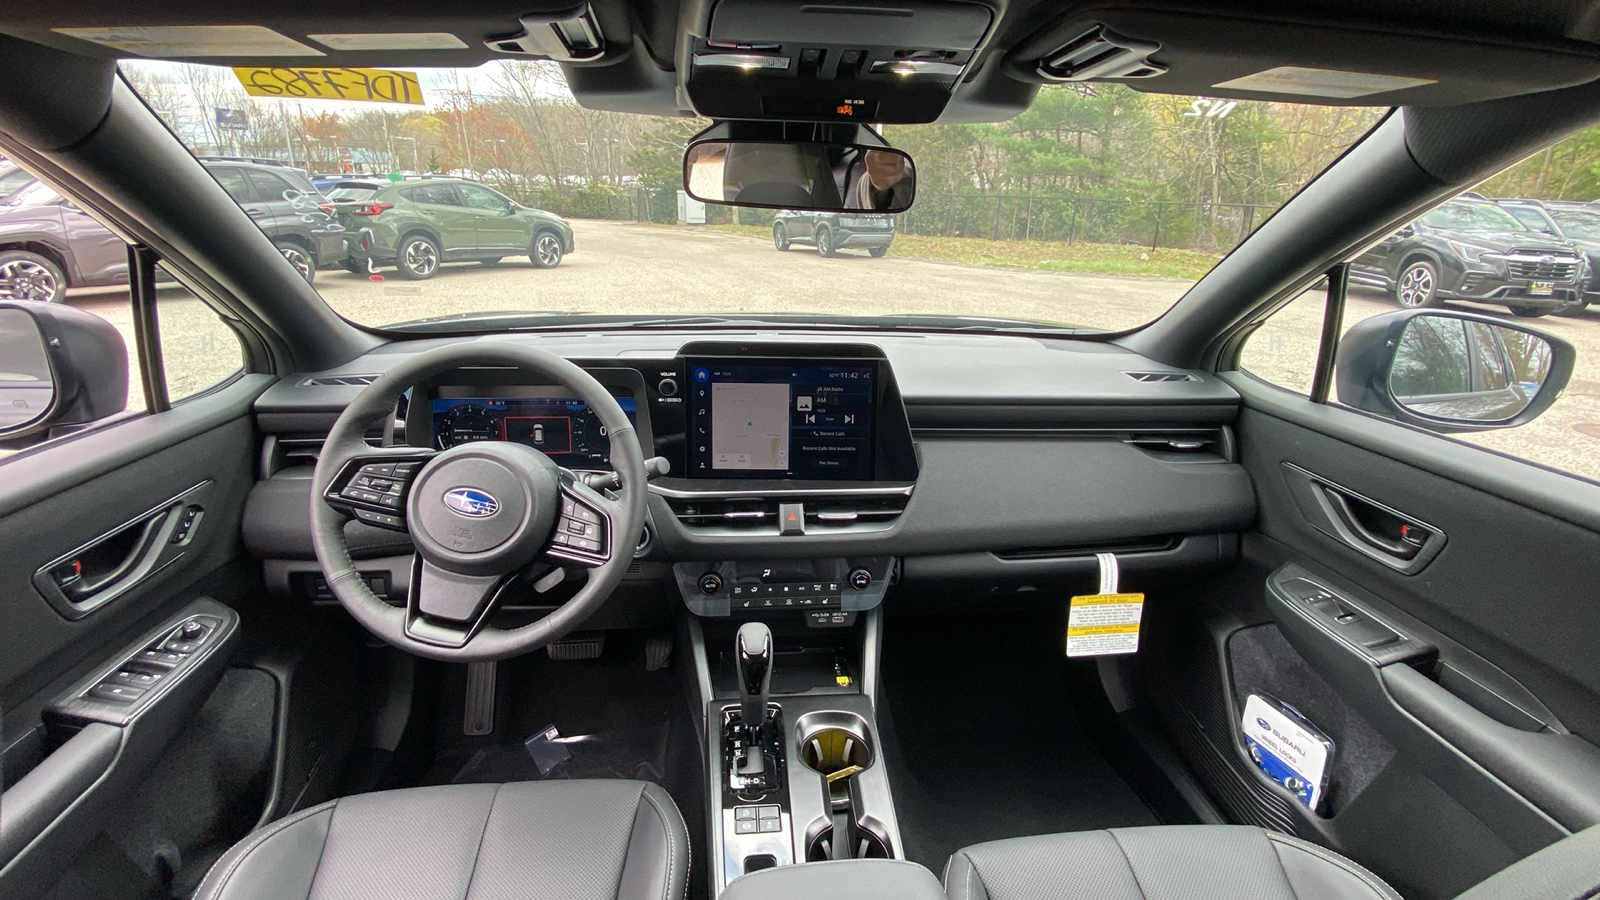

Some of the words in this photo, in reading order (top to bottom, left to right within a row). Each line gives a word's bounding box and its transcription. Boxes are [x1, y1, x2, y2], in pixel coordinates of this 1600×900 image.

[600, 426, 606, 436] 0
[1261, 734, 1279, 751] WHEEL
[1279, 748, 1297, 763] LOCKS
[1272, 729, 1306, 757] SUBARU
